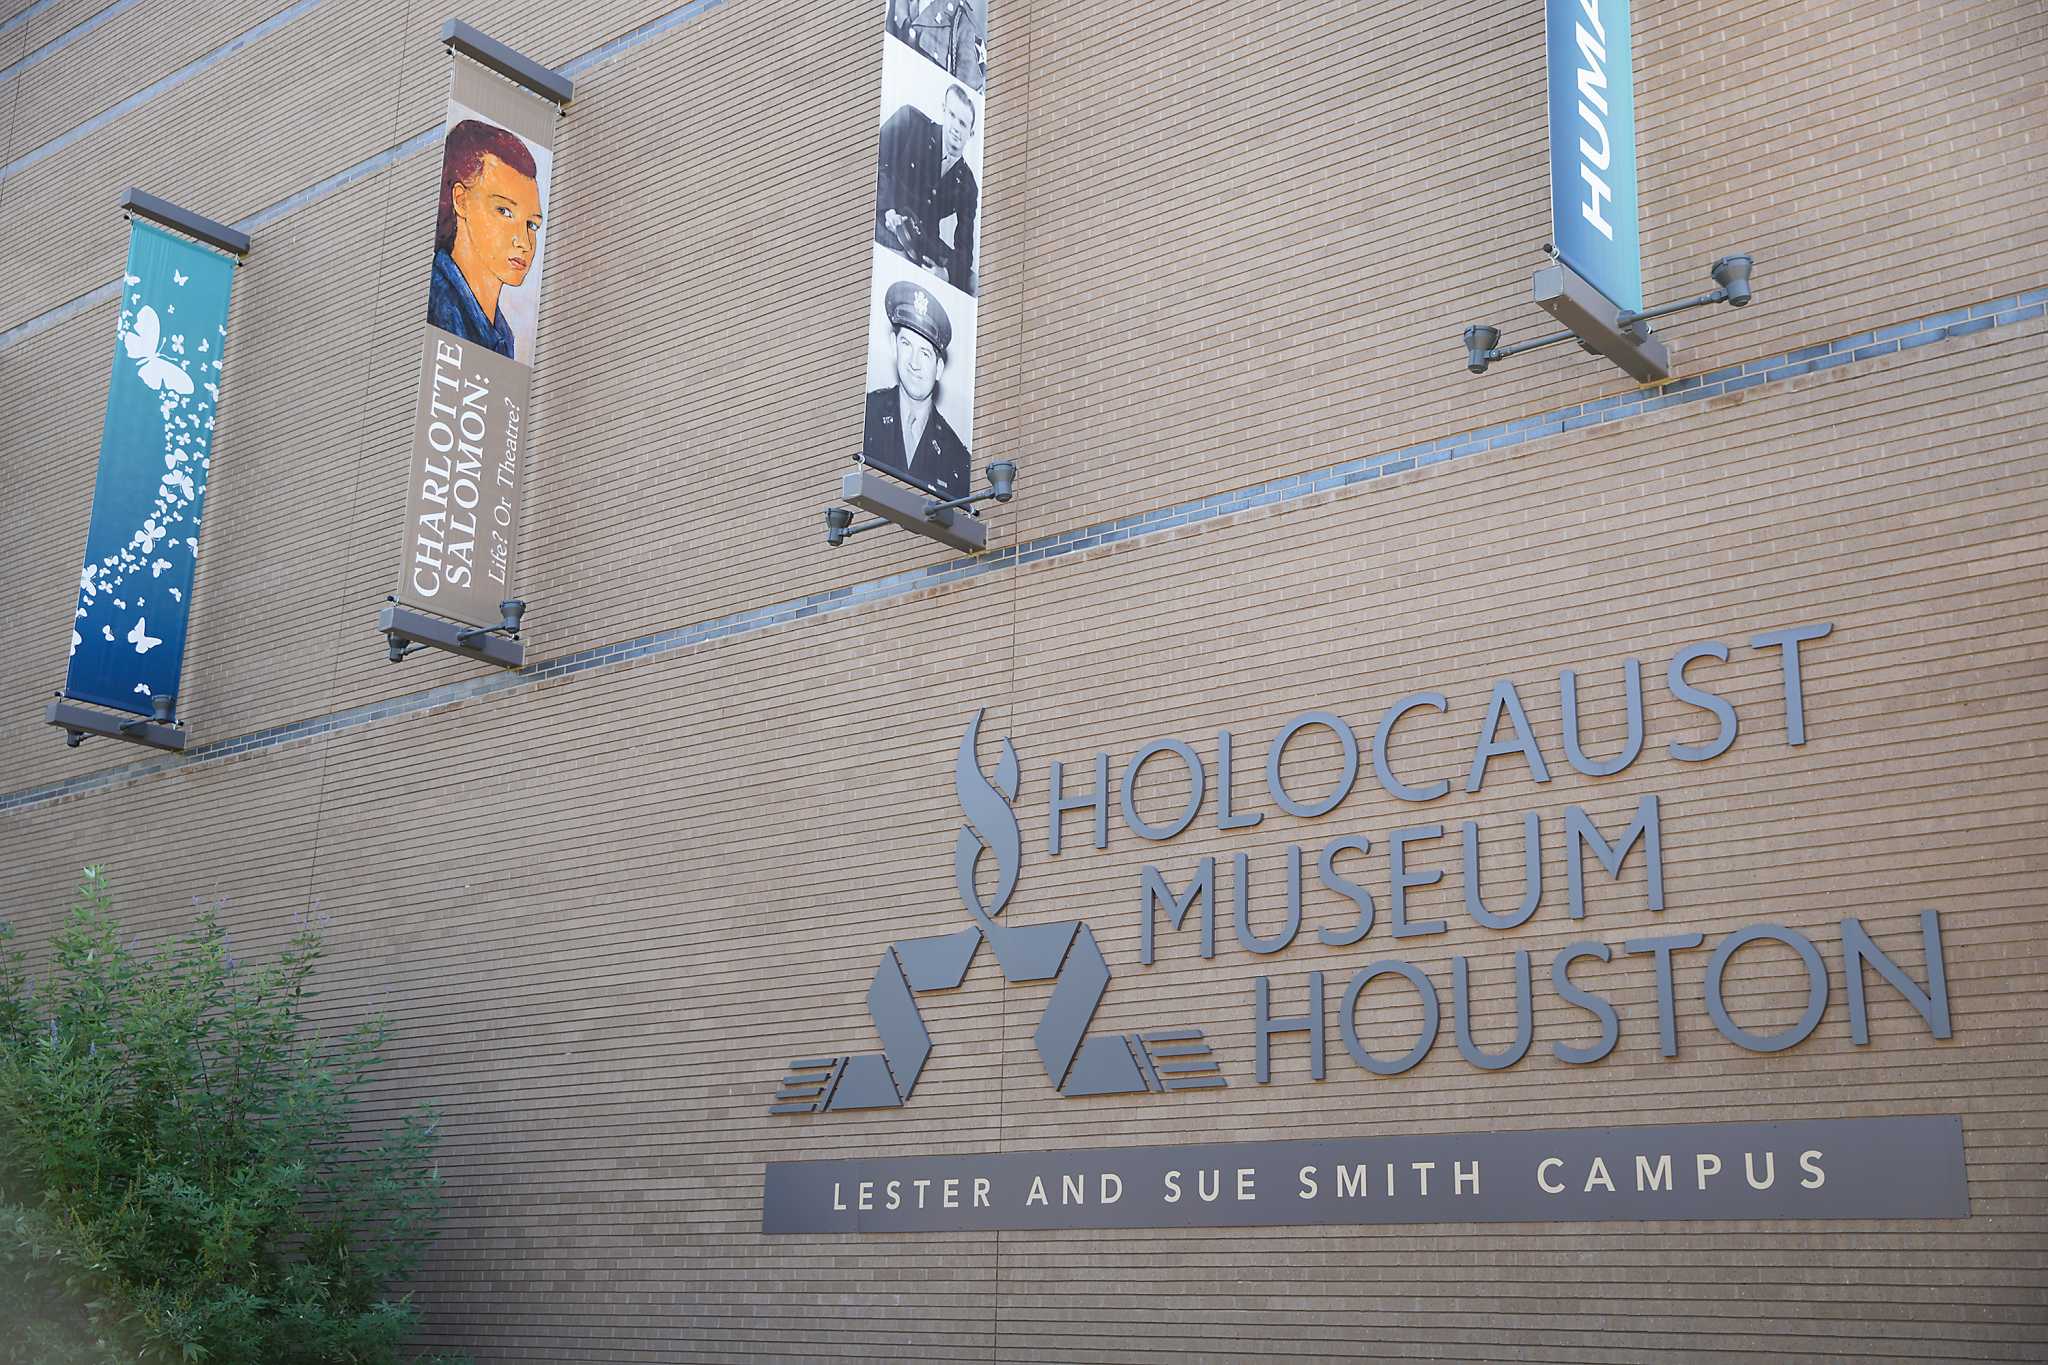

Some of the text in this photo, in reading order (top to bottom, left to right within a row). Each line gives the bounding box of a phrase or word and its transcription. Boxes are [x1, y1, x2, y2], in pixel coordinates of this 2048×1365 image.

[413, 340, 464, 597] CHARLOTTE
[446, 373, 490, 588] SALOMON:
[488, 397, 521, 585] Life? Or Theatre?
[1048, 623, 1833, 856] HOLOCAUST
[1141, 795, 1664, 965] MUSEUM
[1255, 909, 1952, 1084] HOUSTON
[832, 1150, 1827, 1211] LESTER AND SUE SMITH CAMPUS
